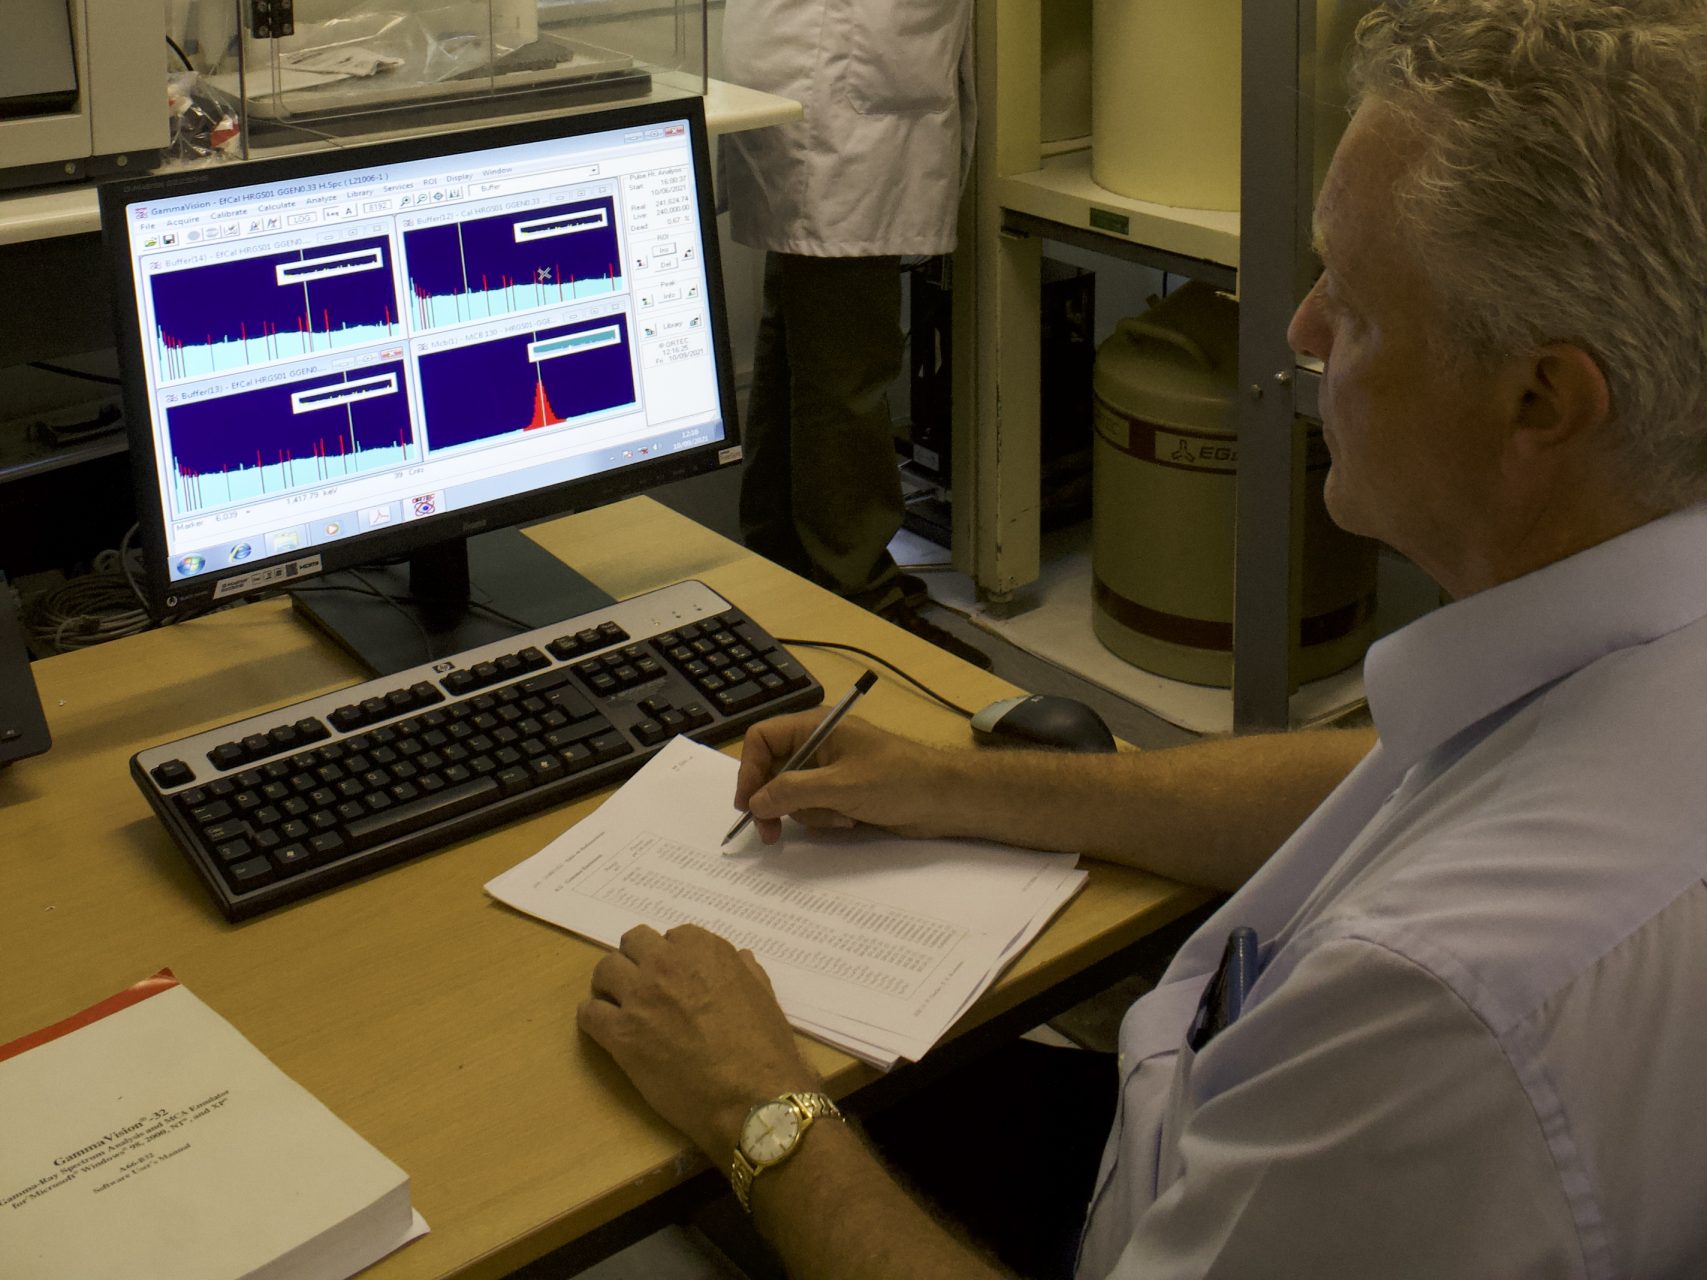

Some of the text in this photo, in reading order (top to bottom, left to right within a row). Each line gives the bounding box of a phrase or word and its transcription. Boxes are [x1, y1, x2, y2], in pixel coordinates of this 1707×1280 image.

[140, 166, 513, 231] File Acquire Calibrate Calculate Analyze Library Services ROI Display Window
[151, 200, 211, 217] GammaVision
[219, 194, 241, 206] EfCal
[242, 190, 275, 202] HRGS01
[0, 1090, 230, 1207] Gamma-Ray Spectrum Analysis and MCA Emulator
[93, 1173, 131, 1195] Software
[159, 1143, 192, 1162] Manual
